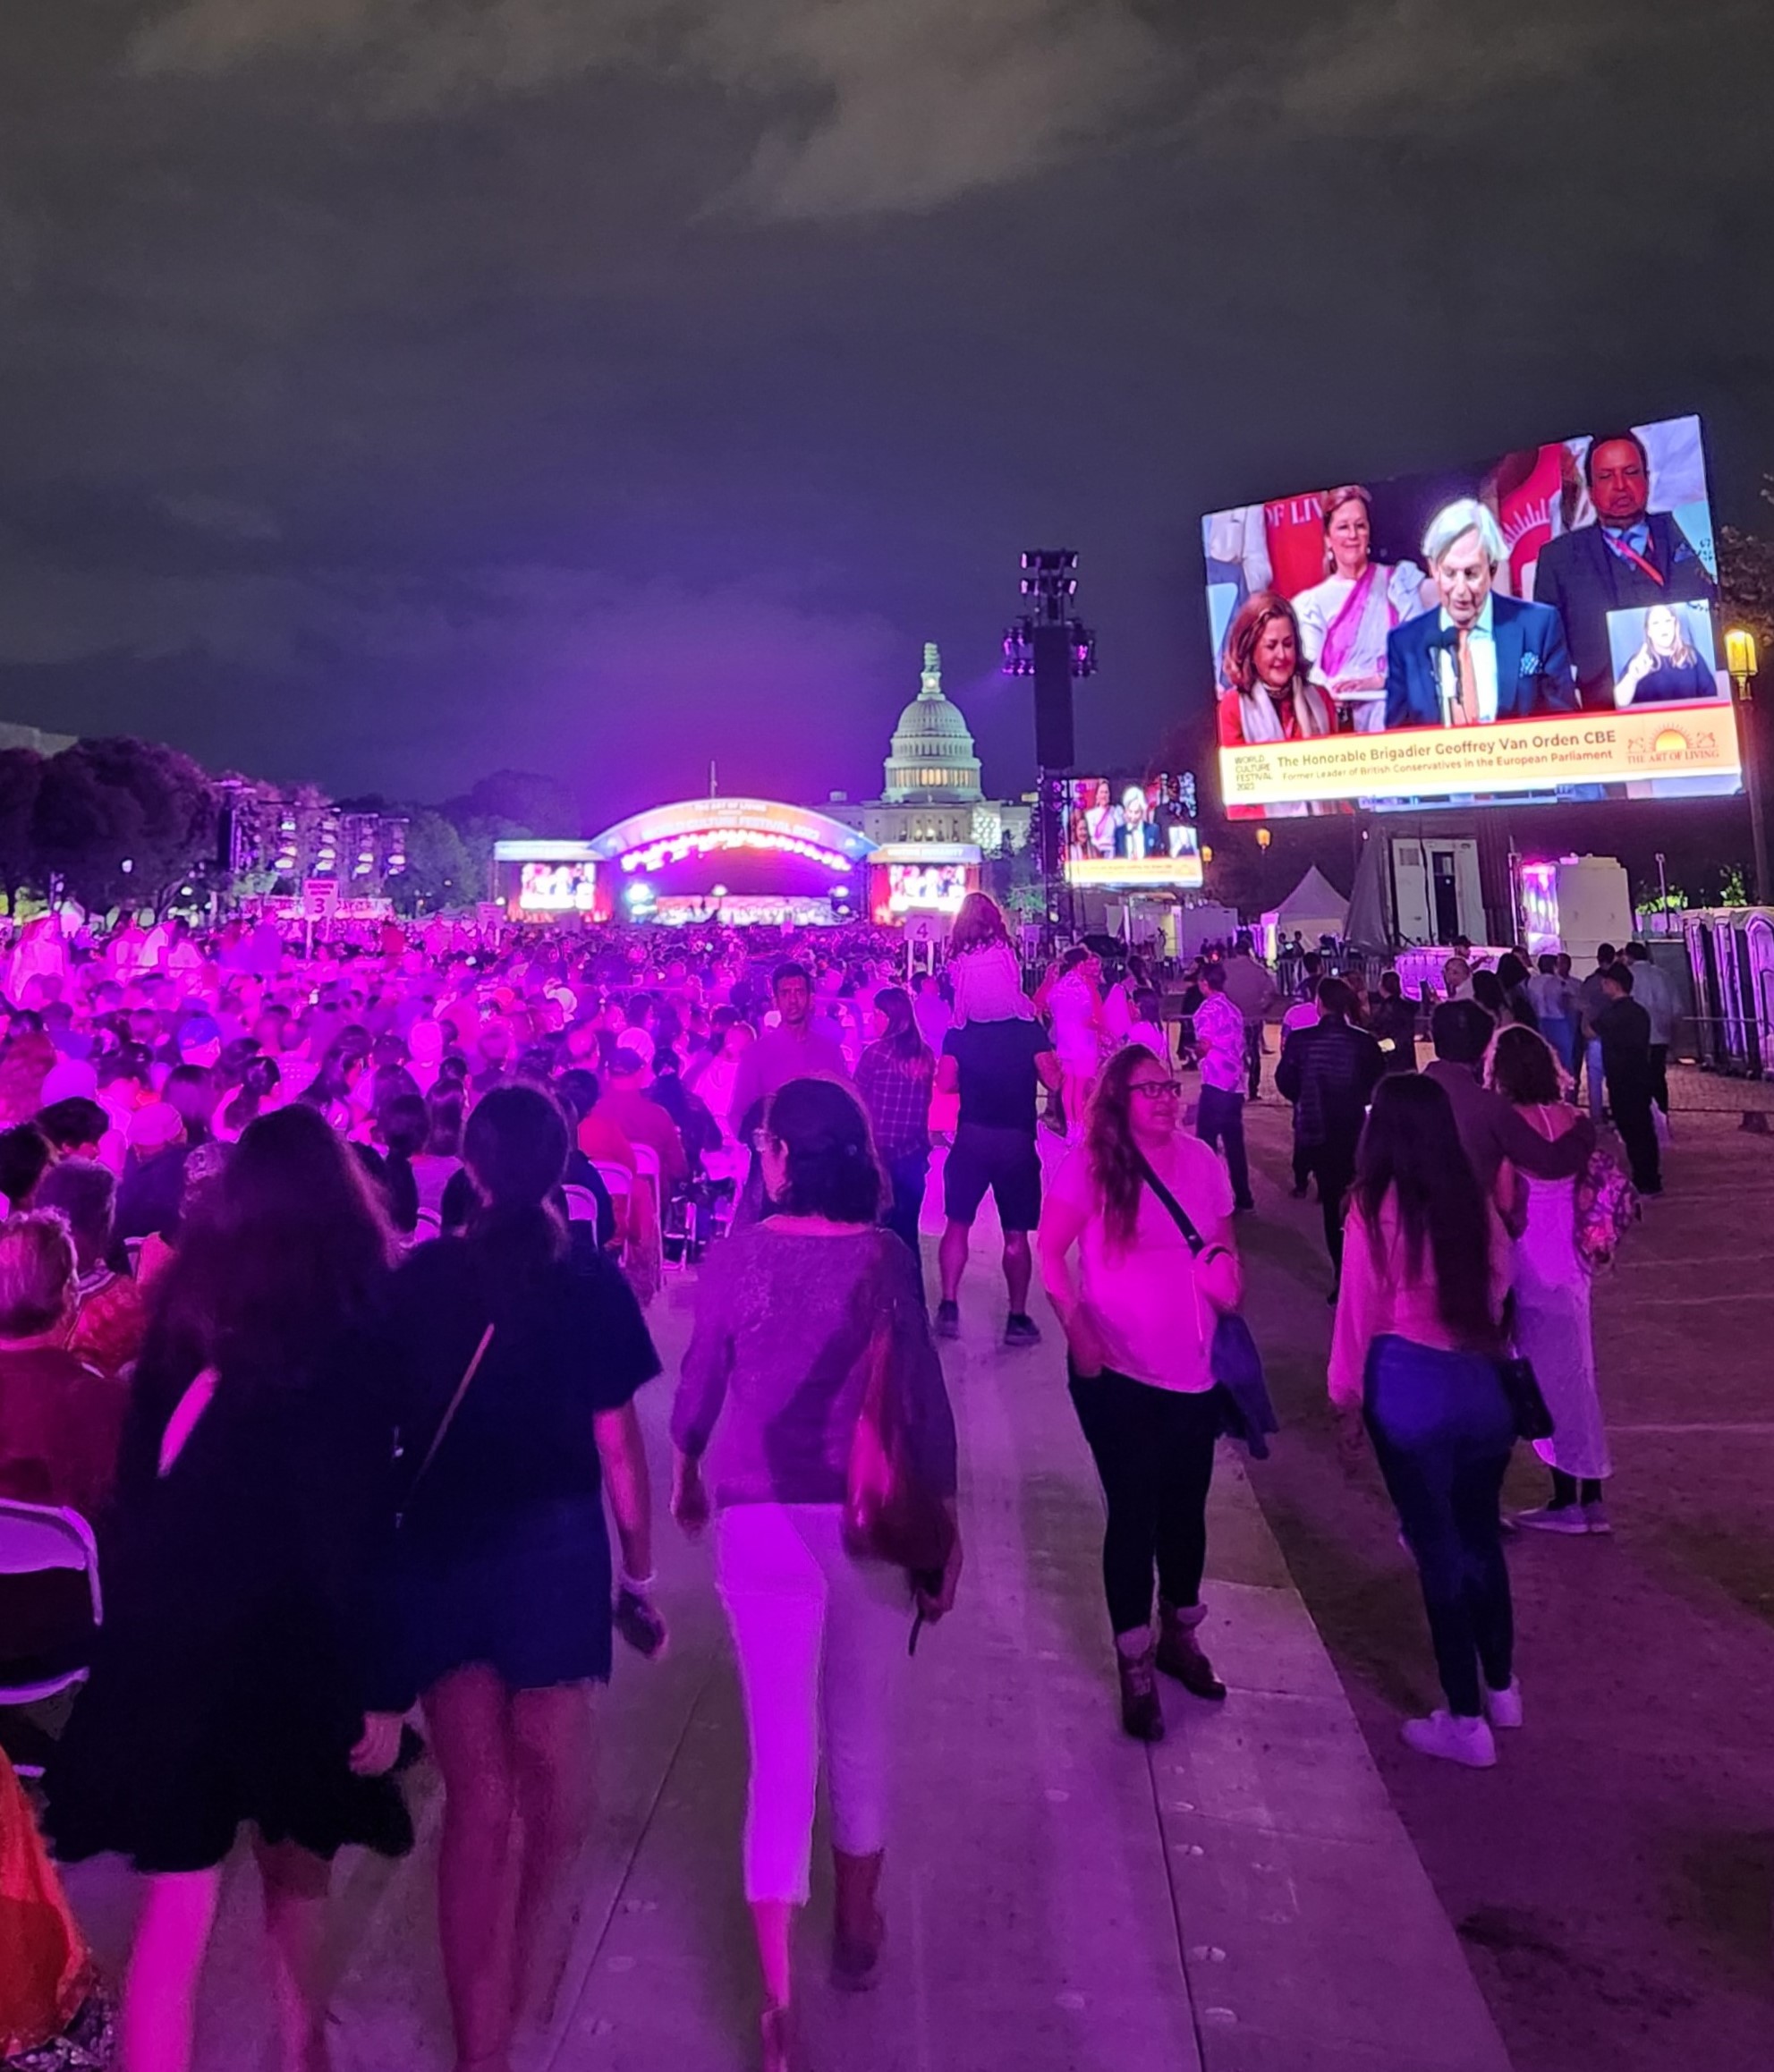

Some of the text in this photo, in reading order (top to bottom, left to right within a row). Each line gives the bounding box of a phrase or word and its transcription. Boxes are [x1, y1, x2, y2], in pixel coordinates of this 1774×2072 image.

[1277, 730, 1617, 769] The Honorable Brigadier Geoffrey Van Orden CBE
[1627, 749, 1719, 765] THE ART OF LIVING
[1235, 754, 1265, 765] WORLD
[1282, 749, 1613, 781] Former Leader of British Conservatives in the European Parliament
[1235, 763, 1271, 774] CULTURE
[1235, 772, 1273, 783] FESTIVAL
[314, 897, 326, 913] 3
[916, 922, 929, 938] 4
